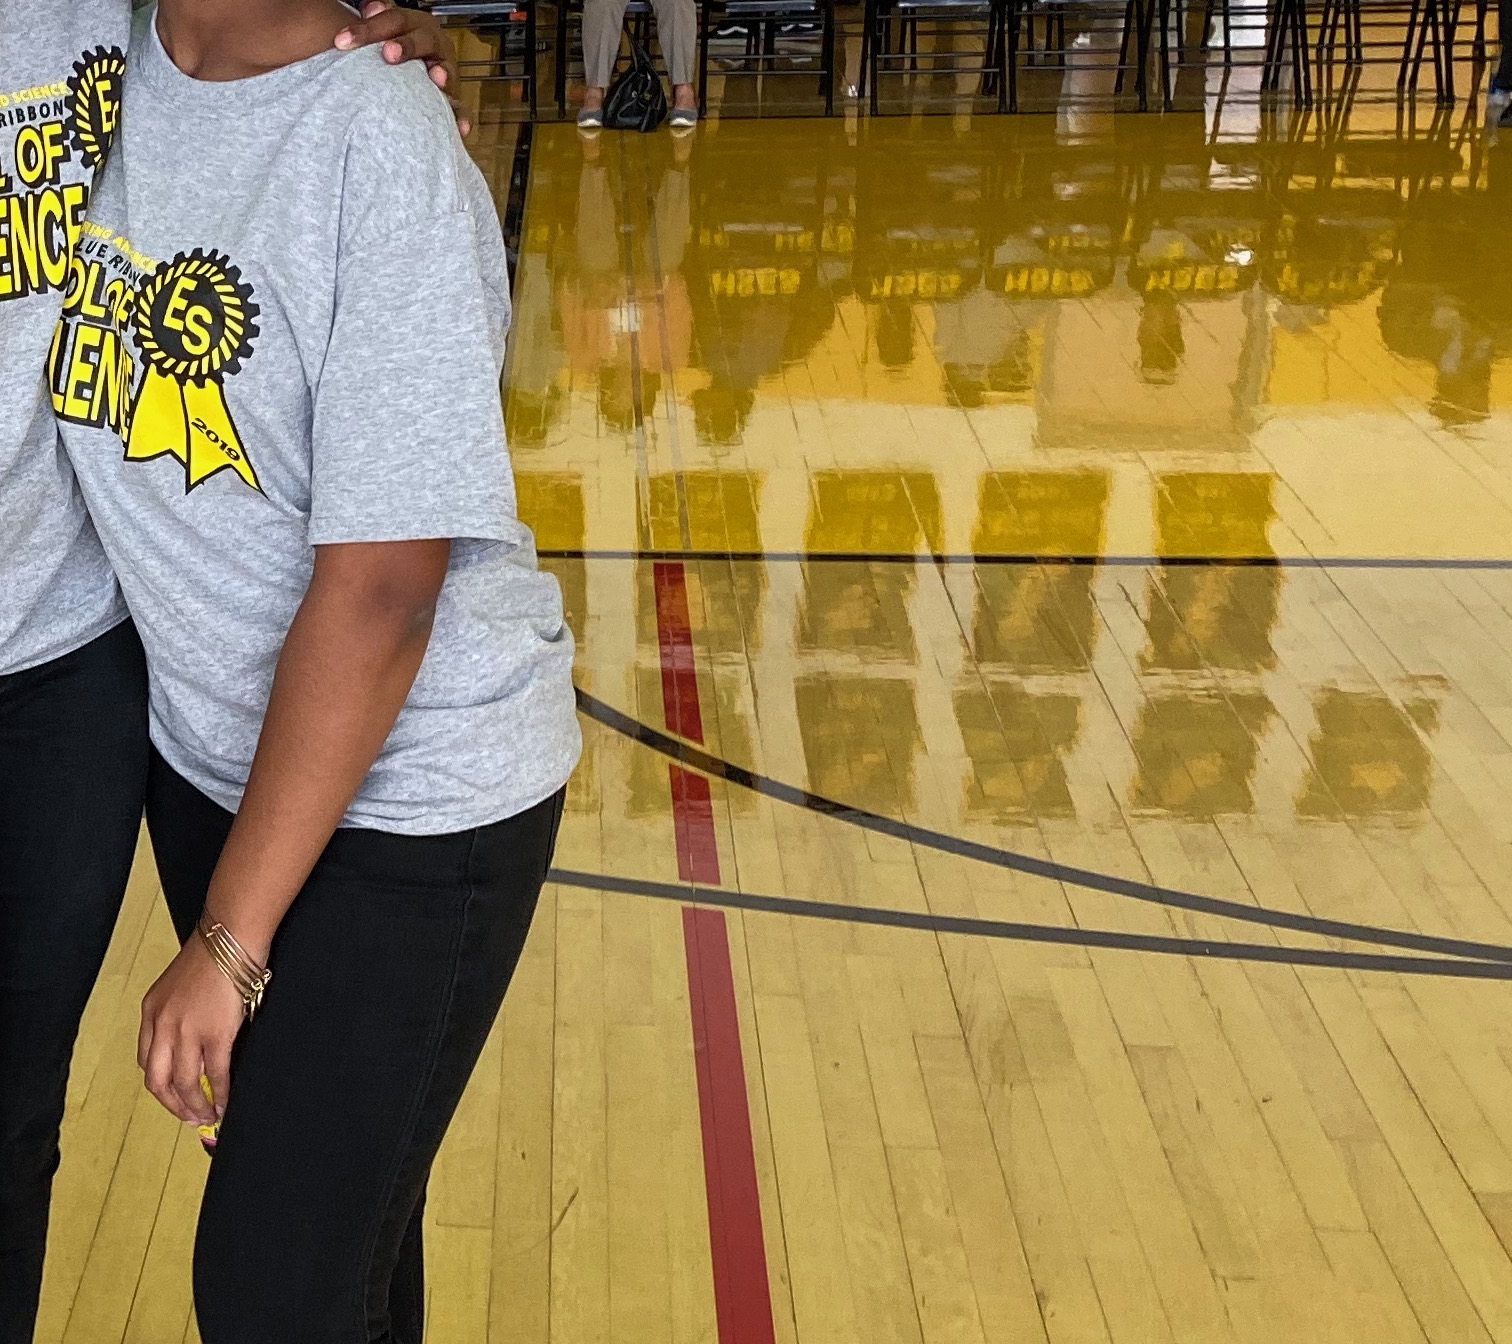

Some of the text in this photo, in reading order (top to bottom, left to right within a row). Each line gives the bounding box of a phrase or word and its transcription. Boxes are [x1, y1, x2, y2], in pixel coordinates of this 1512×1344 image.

[15, 120, 72, 188] OF
[163, 275, 213, 356] ES
[191, 417, 241, 462] 2019
